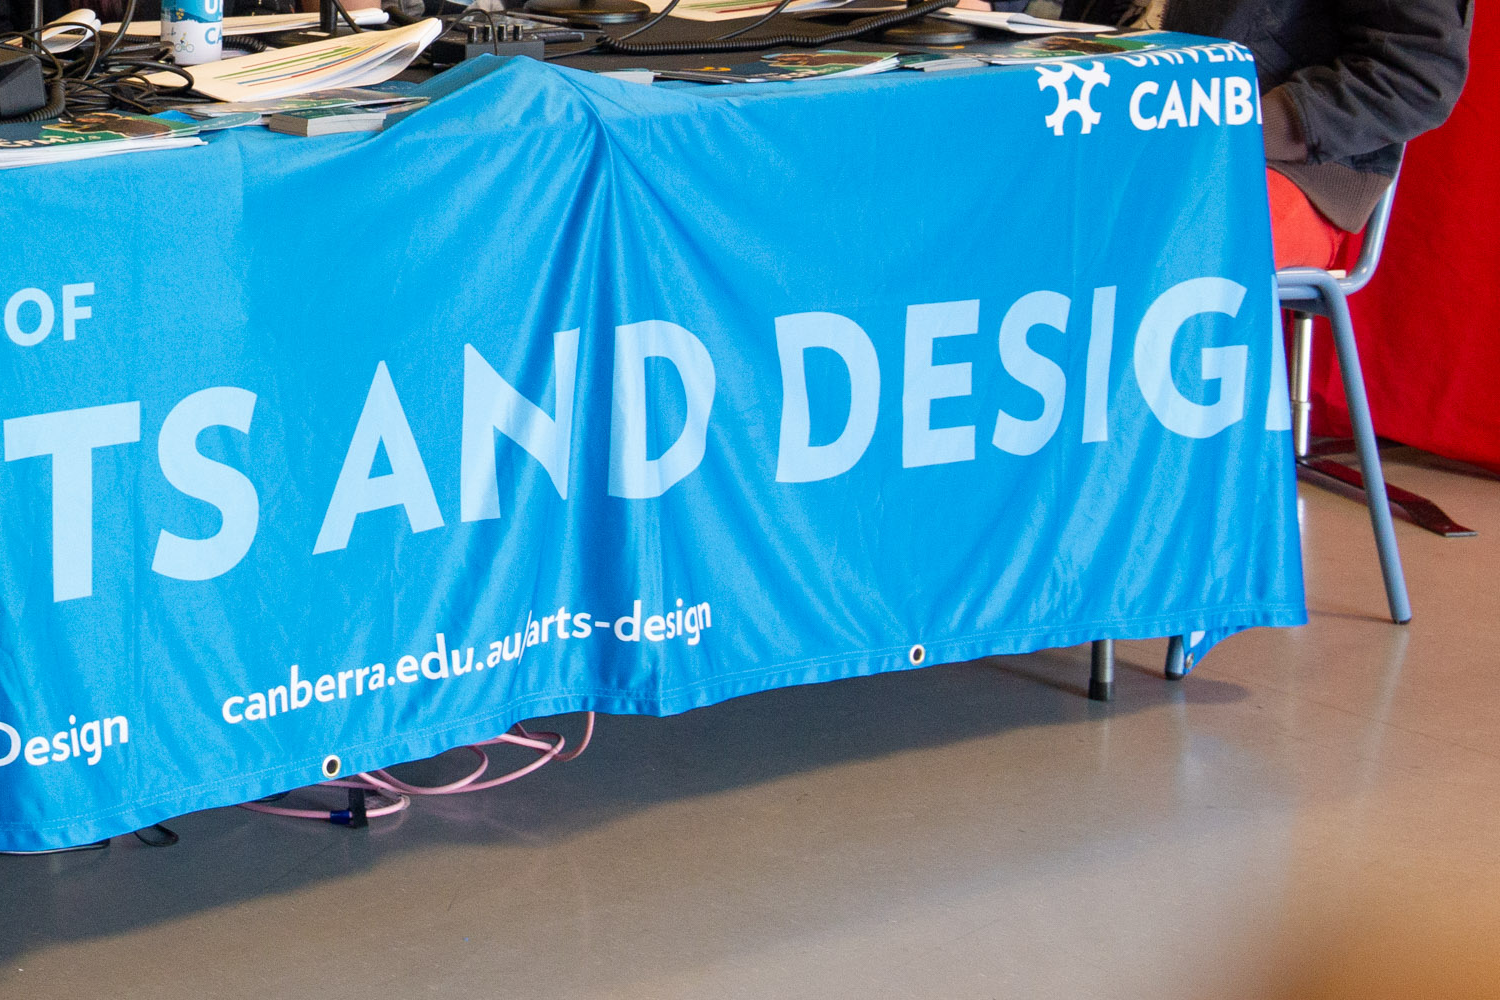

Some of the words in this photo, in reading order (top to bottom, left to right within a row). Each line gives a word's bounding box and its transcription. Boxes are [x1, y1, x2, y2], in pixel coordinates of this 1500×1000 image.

[3, 281, 95, 347] OF
[312, 319, 717, 556] AND
[221, 598, 712, 725] canberra.edu.au/arts-design
